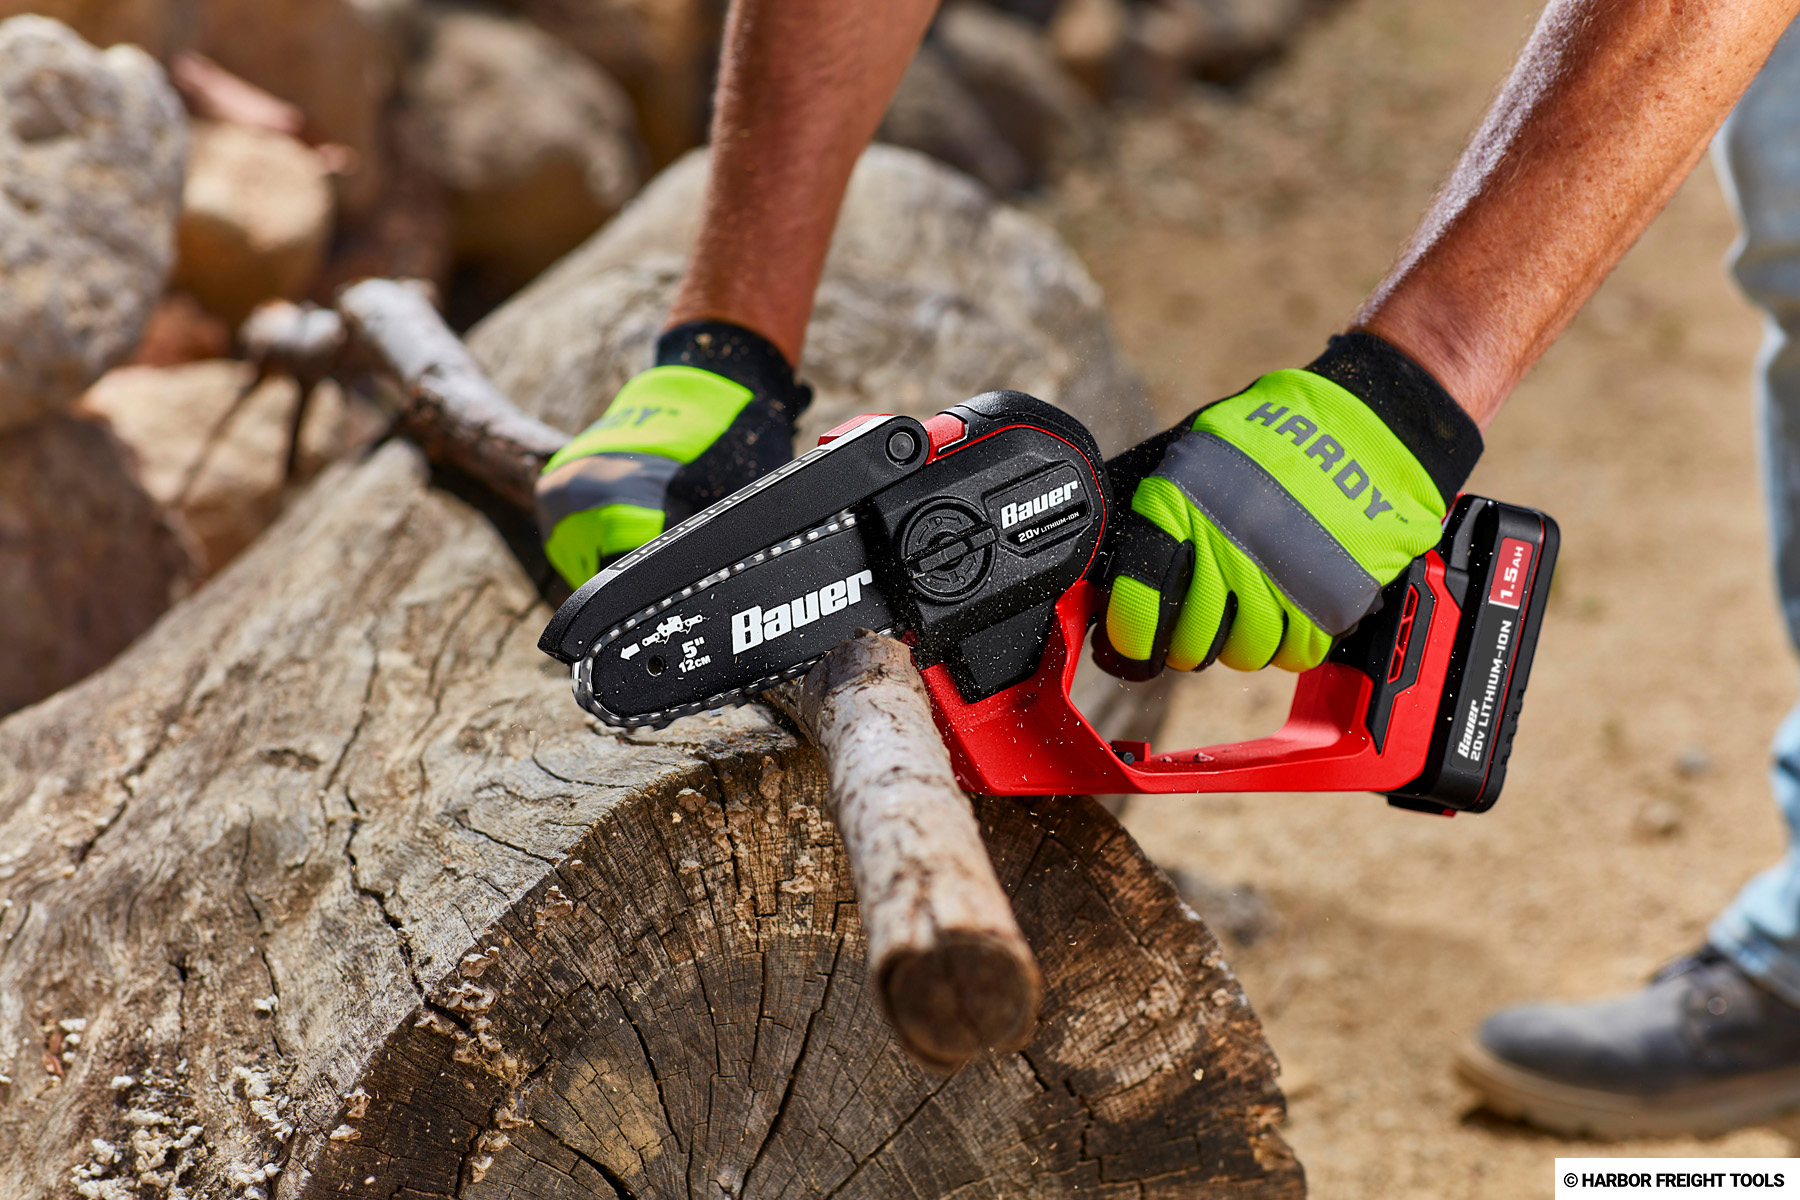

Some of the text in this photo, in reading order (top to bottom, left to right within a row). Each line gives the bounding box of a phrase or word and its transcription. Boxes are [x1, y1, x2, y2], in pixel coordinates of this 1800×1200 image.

[616, 449, 824, 568] BRUSHLESS
[1001, 480, 1078, 530] Bauer
[731, 569, 873, 655] Bauer
[1478, 619, 1512, 727] LITHIUM-ION
[1457, 699, 1480, 759] Bauer
